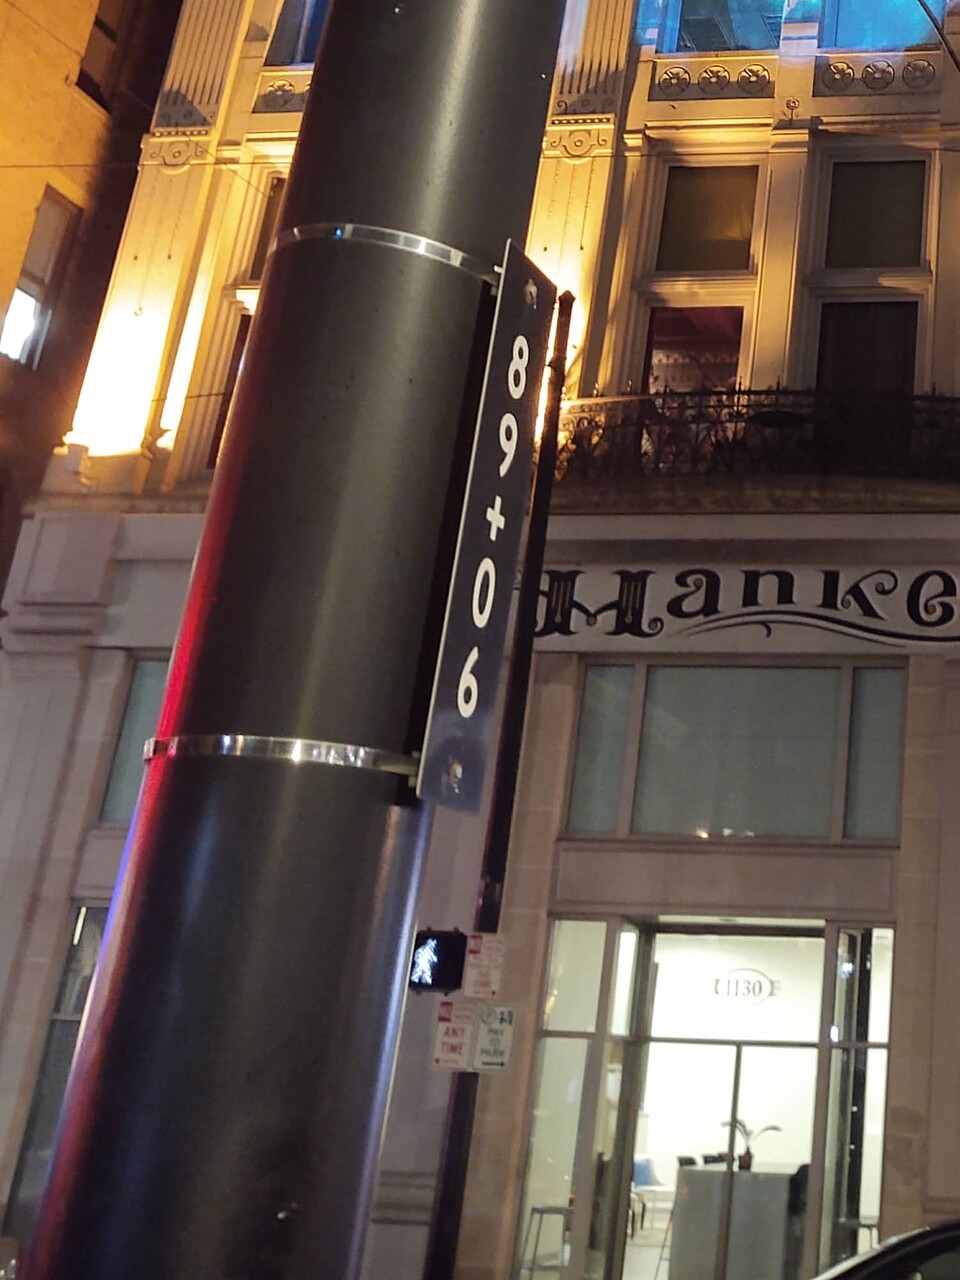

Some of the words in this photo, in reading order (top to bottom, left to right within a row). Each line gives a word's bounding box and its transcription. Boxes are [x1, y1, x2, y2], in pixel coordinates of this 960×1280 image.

[534, 569, 958, 638] Hanke
[726, 979, 763, 997] 1130
[444, 1026, 465, 1037] ANY
[442, 1042, 464, 1055] TIME
